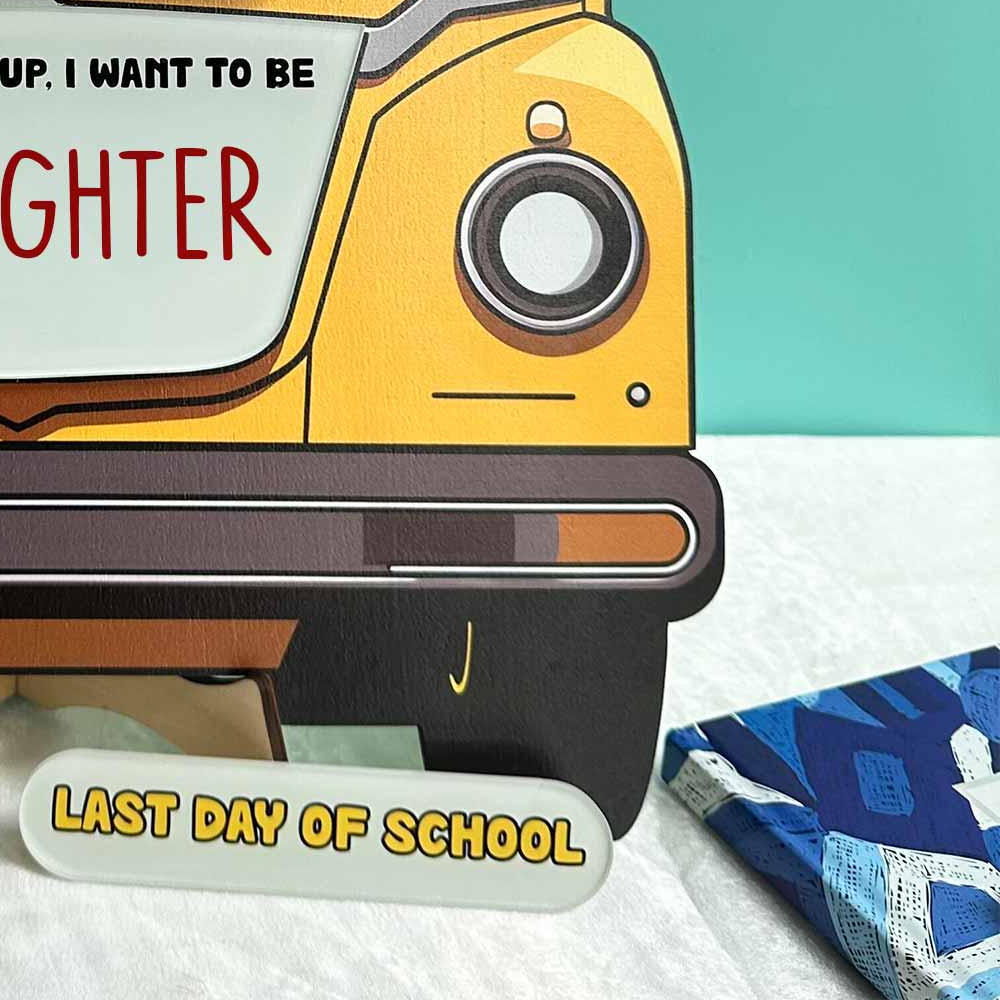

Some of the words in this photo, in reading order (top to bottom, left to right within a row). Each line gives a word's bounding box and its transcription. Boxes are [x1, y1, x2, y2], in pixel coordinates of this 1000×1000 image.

[0, 57, 52, 91] UP,
[65, 58, 76, 89] I
[89, 57, 194, 89] WANT
[205, 57, 252, 88] TO
[266, 57, 315, 89] BE
[51, 785, 181, 839] LAST
[191, 794, 289, 847] DAY
[298, 802, 371, 852] OF
[381, 808, 586, 866] SCHOOL
